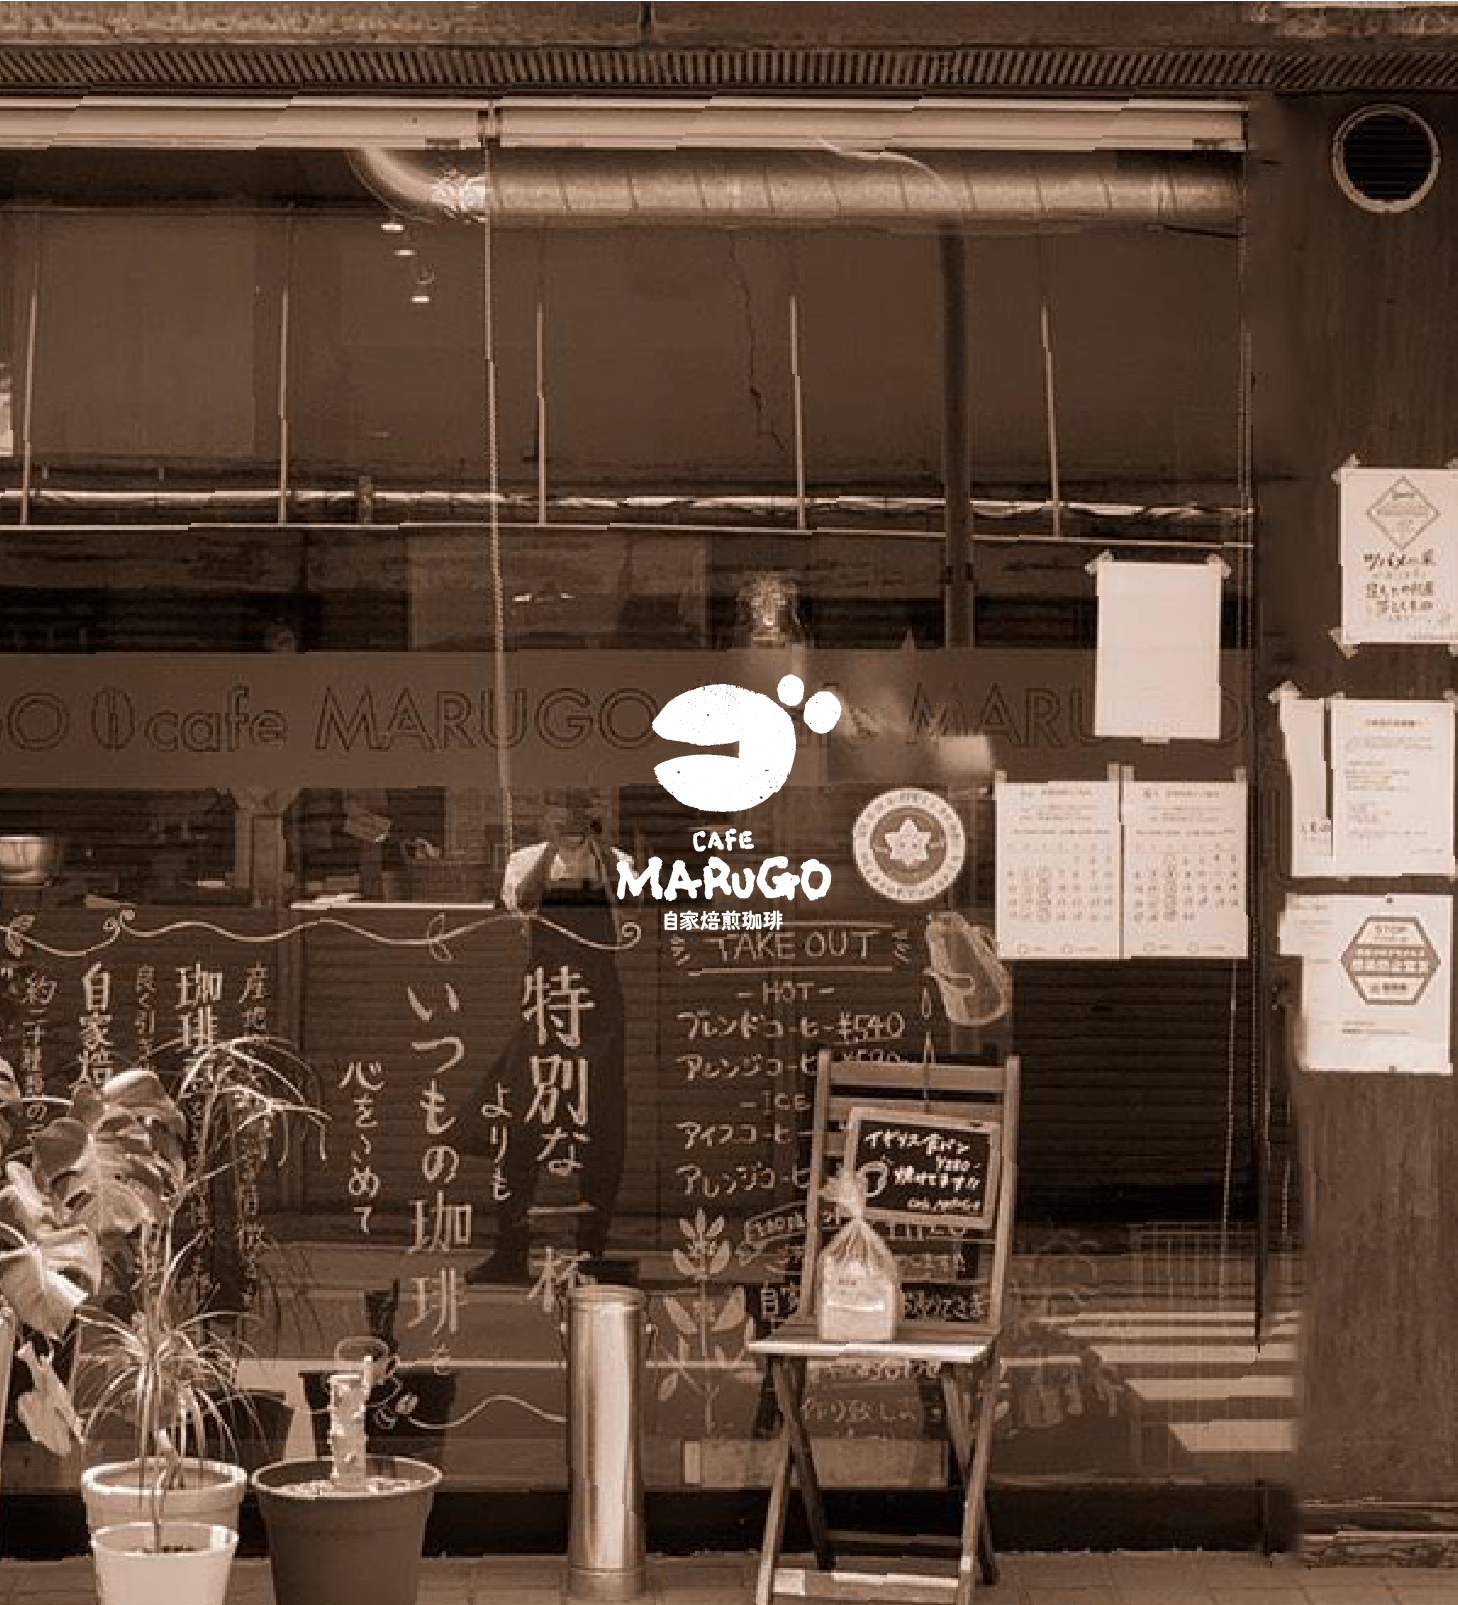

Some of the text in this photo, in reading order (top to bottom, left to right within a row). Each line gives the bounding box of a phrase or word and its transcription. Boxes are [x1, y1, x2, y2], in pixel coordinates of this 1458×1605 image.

[145, 686, 287, 752] cafe
[314, 686, 661, 752] MARUGO
[704, 930, 881, 961] TAKE OUT
